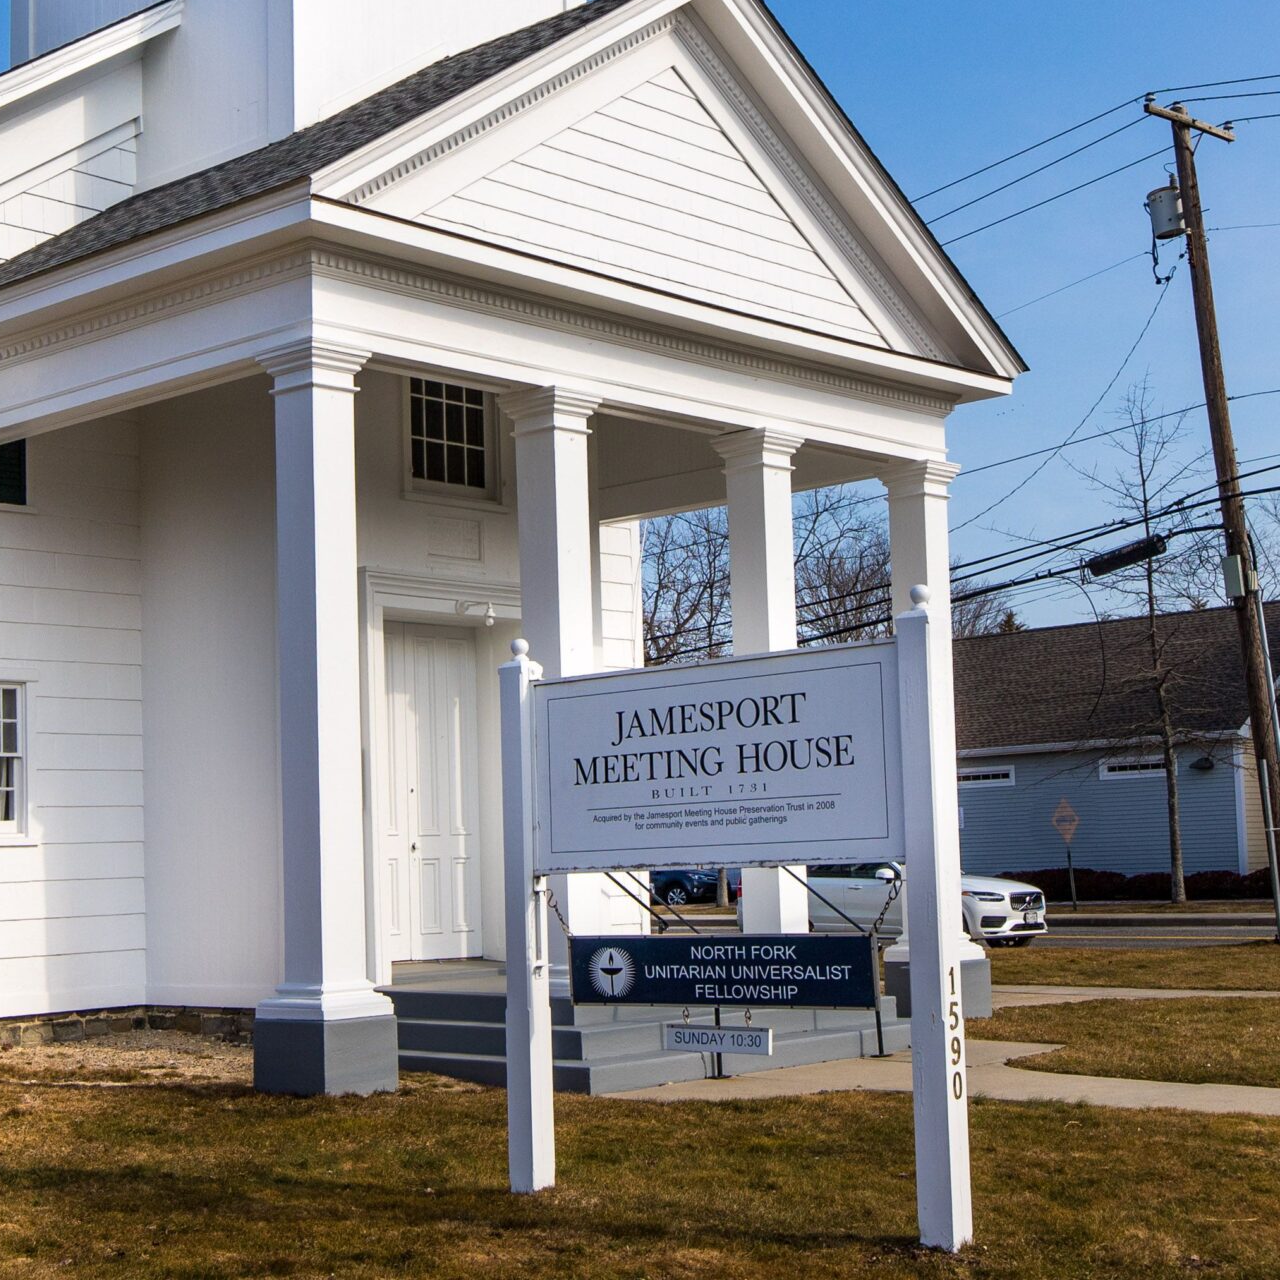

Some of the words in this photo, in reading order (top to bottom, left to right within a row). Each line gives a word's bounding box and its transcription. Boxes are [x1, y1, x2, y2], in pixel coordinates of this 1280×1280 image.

[611, 692, 807, 747] JAMESPORT
[573, 746, 725, 786] MEETING
[735, 734, 855, 774] HOUSE
[651, 785, 713, 800] BUILT
[728, 782, 767, 794] 1731
[592, 814, 622, 824] Acquired
[623, 814, 632, 822] by
[633, 812, 645, 820] the
[646, 810, 683, 820] Jamesport
[684, 808, 712, 818] Meeting
[713, 807, 738, 816] House
[739, 804, 785, 815] Preservation
[786, 802, 805, 812] Trust
[807, 801, 814, 810] in
[815, 800, 836, 810] 2008
[645, 821, 684, 830] community
[684, 819, 709, 828] events
[709, 818, 724, 826] and
[725, 815, 747, 827] public
[748, 814, 788, 826] gatherings
[690, 945, 746, 960] NORTH
[751, 945, 797, 960] FORK
[644, 965, 727, 980] UNITARIAN
[731, 965, 852, 980] UNIVERSALIST
[695, 984, 798, 1000] FELLOWSHIP
[674, 1031, 727, 1046] SUNDAY
[730, 1033, 762, 1048] 10:30
[948, 966, 963, 1100] 1590
